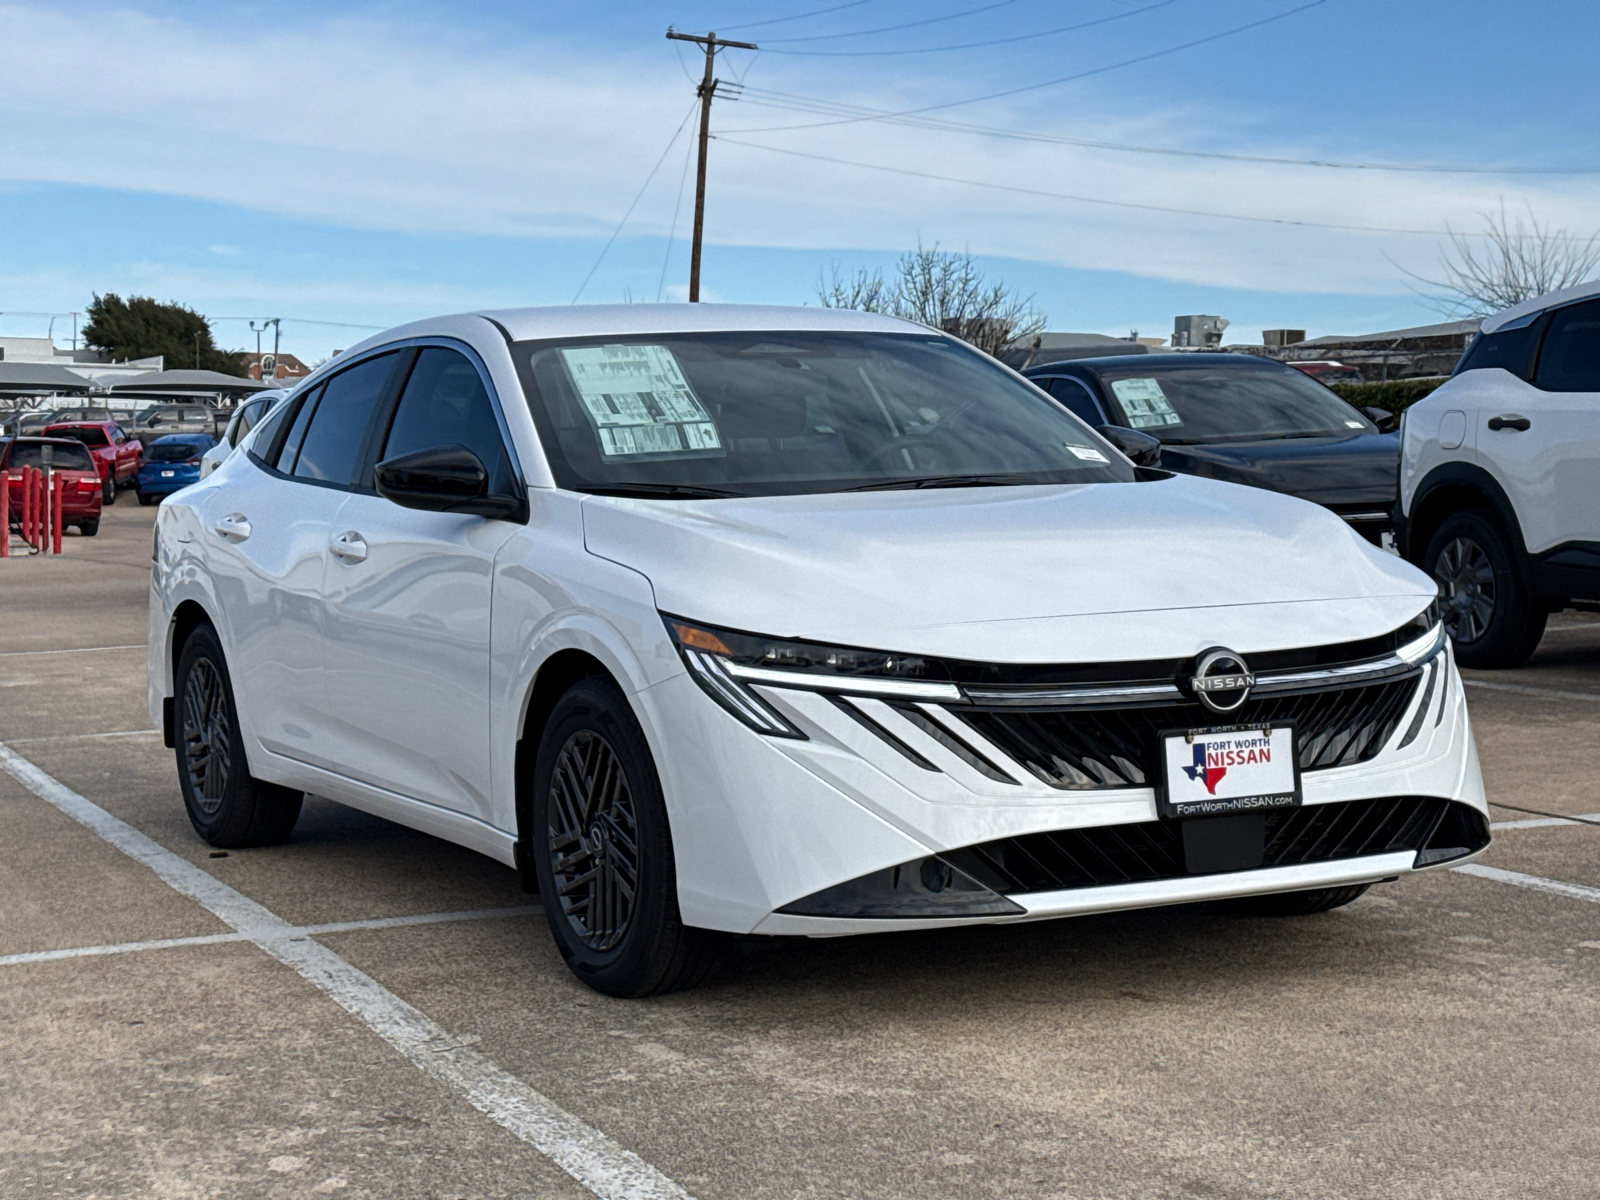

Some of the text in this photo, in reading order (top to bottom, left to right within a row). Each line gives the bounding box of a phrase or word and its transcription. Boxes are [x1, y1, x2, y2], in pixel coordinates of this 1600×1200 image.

[1194, 676, 1255, 690] NISSAN
[1188, 722, 1271, 735] FORT WORTH TEXAS
[1206, 738, 1270, 751] FORT WORTH
[1207, 748, 1271, 767] NISSAN
